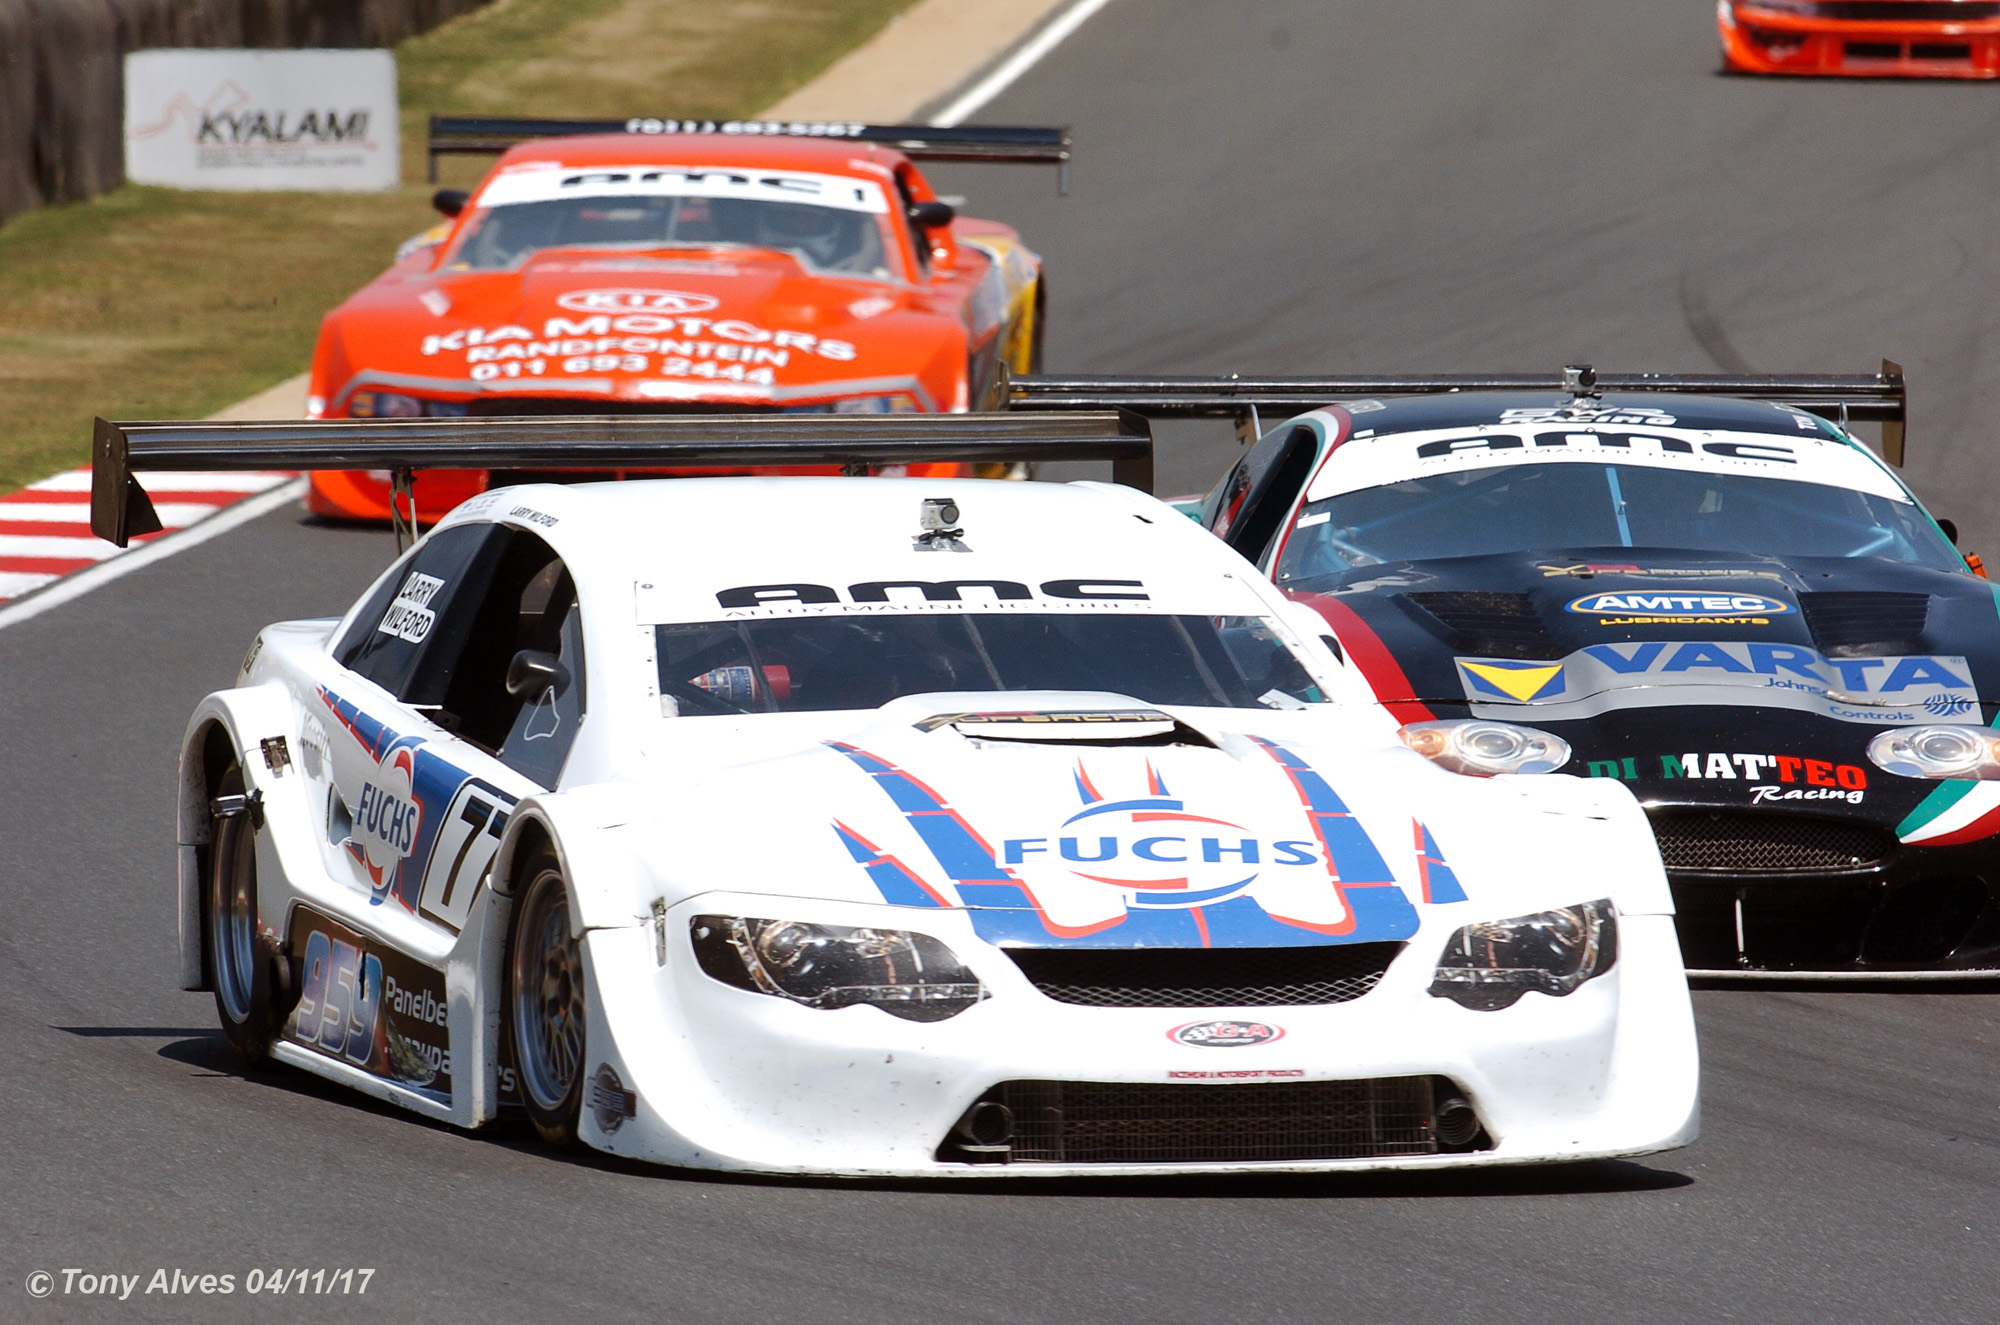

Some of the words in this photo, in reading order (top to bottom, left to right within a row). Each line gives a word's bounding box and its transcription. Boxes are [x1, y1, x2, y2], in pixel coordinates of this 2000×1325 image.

[199, 109, 370, 143] KYALAMI
[584, 292, 690, 309] KIA
[421, 326, 534, 355] KIA
[544, 314, 857, 361] MOTORS
[466, 337, 790, 367] RANDFONTEIN
[470, 357, 546, 381] 011
[562, 354, 649, 373] 693
[662, 356, 775, 386] 2444
[1416, 431, 1798, 464] amc
[400, 576, 440, 605] LARRY
[715, 579, 1151, 608] amc
[1593, 596, 1766, 610] AMTEC
[1600, 617, 1770, 626] LUBRICANTS
[1581, 643, 1974, 692] VARTA
[1765, 677, 1829, 697] Johns
[1829, 706, 1915, 721] Controls
[1587, 756, 1639, 780] DI
[1749, 785, 1864, 804] Racing
[356, 782, 417, 853] FUCHS
[1003, 836, 1319, 866] FUCHS
[296, 929, 383, 1066] 959
